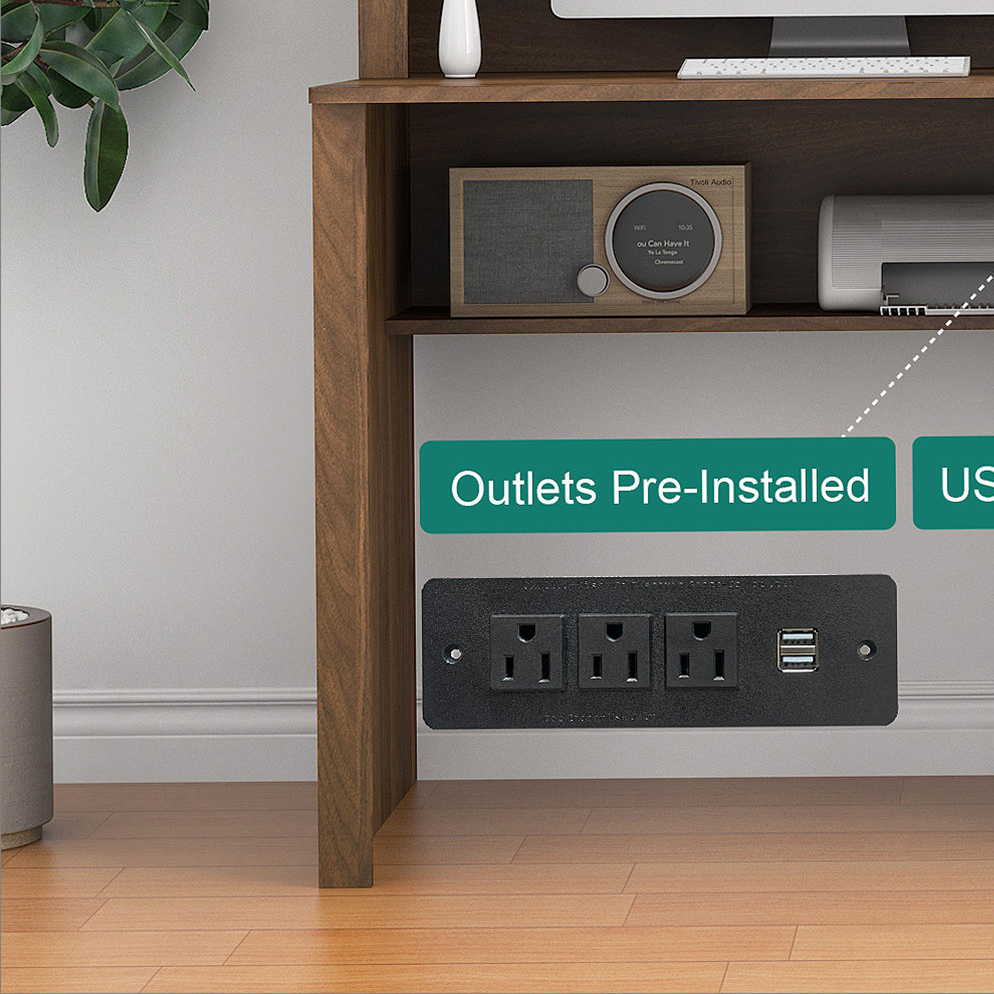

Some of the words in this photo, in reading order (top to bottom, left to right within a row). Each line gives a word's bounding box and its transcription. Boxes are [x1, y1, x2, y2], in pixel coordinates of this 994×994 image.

[711, 178, 732, 186] Audio
[647, 239, 662, 247] Can
[663, 239, 683, 247] Have
[683, 239, 690, 247] It
